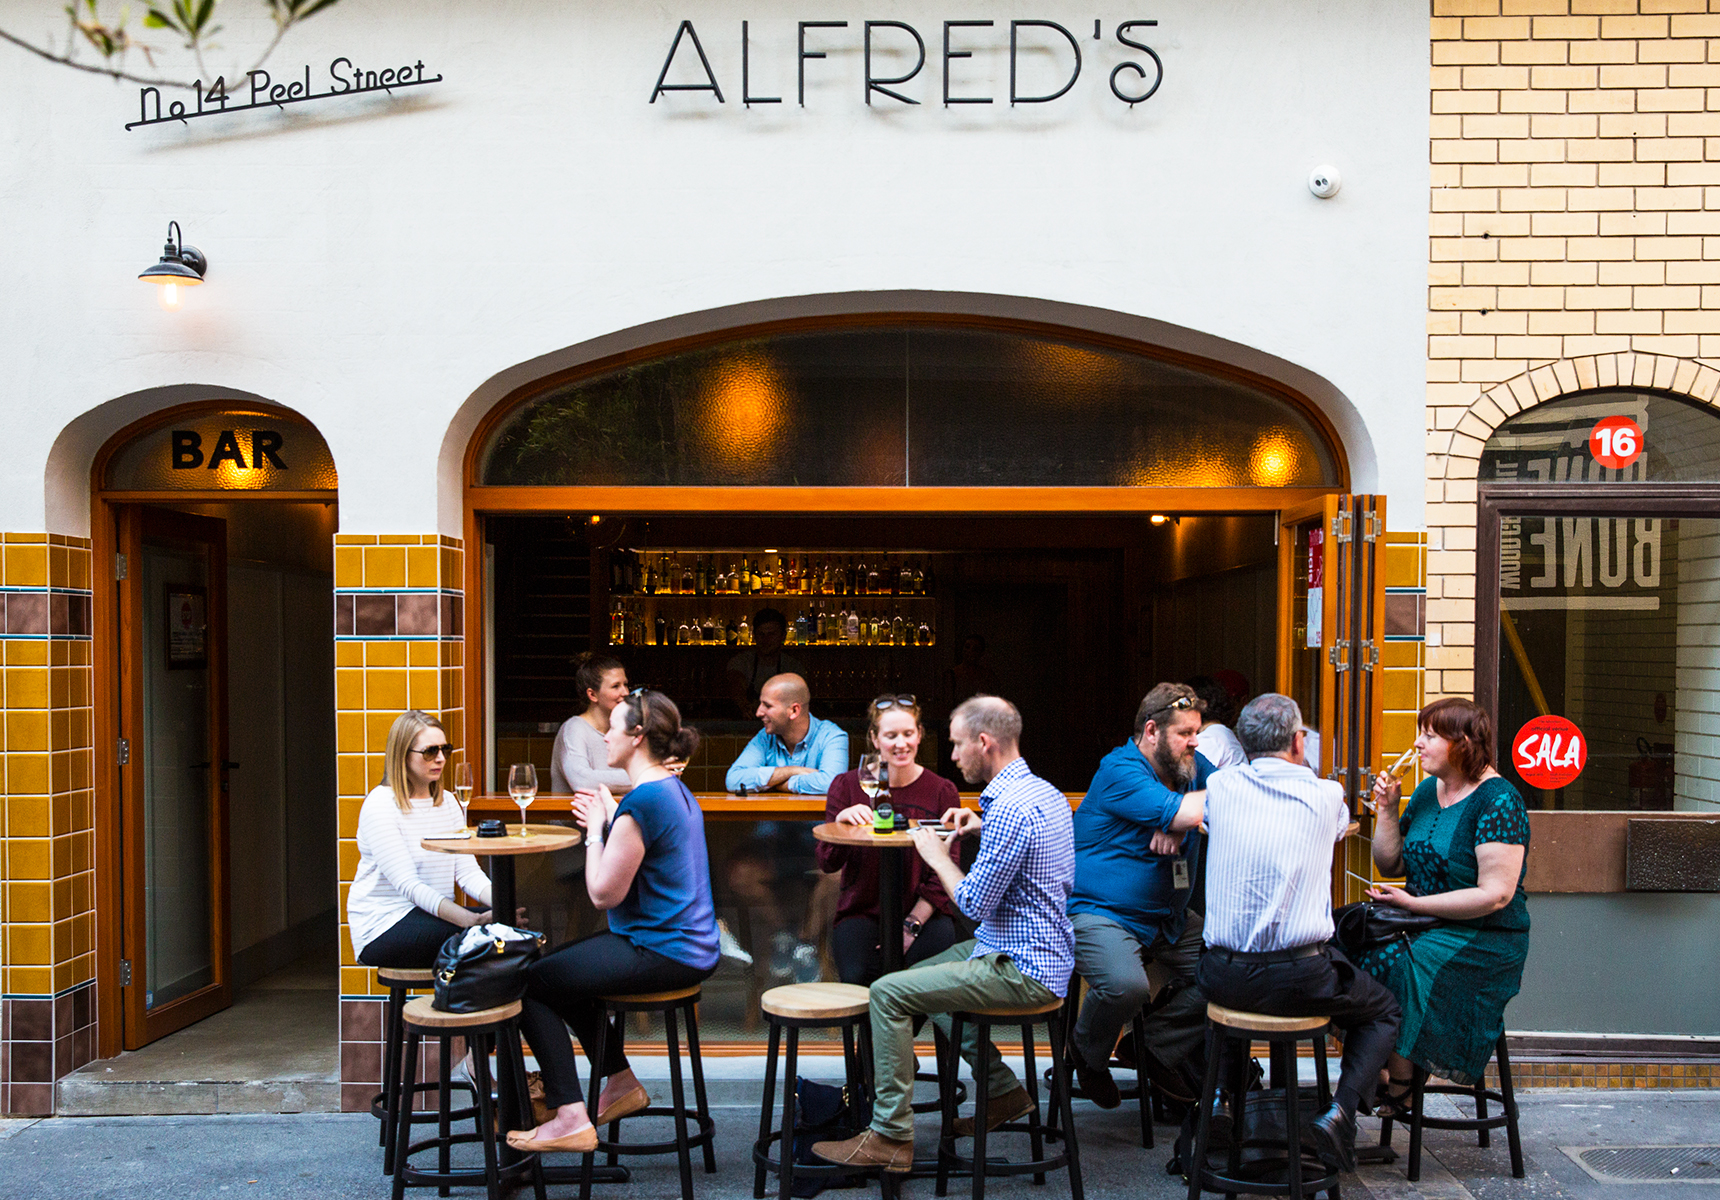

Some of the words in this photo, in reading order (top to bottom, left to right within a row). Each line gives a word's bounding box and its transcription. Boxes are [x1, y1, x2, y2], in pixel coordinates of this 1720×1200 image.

[649, 19, 1163, 105] ALFRED'S
[246, 65, 310, 107] Peel
[330, 57, 425, 94] Street
[172, 430, 288, 469] BAR
[1595, 427, 1636, 457] 16
[1518, 733, 1580, 771] SALA
